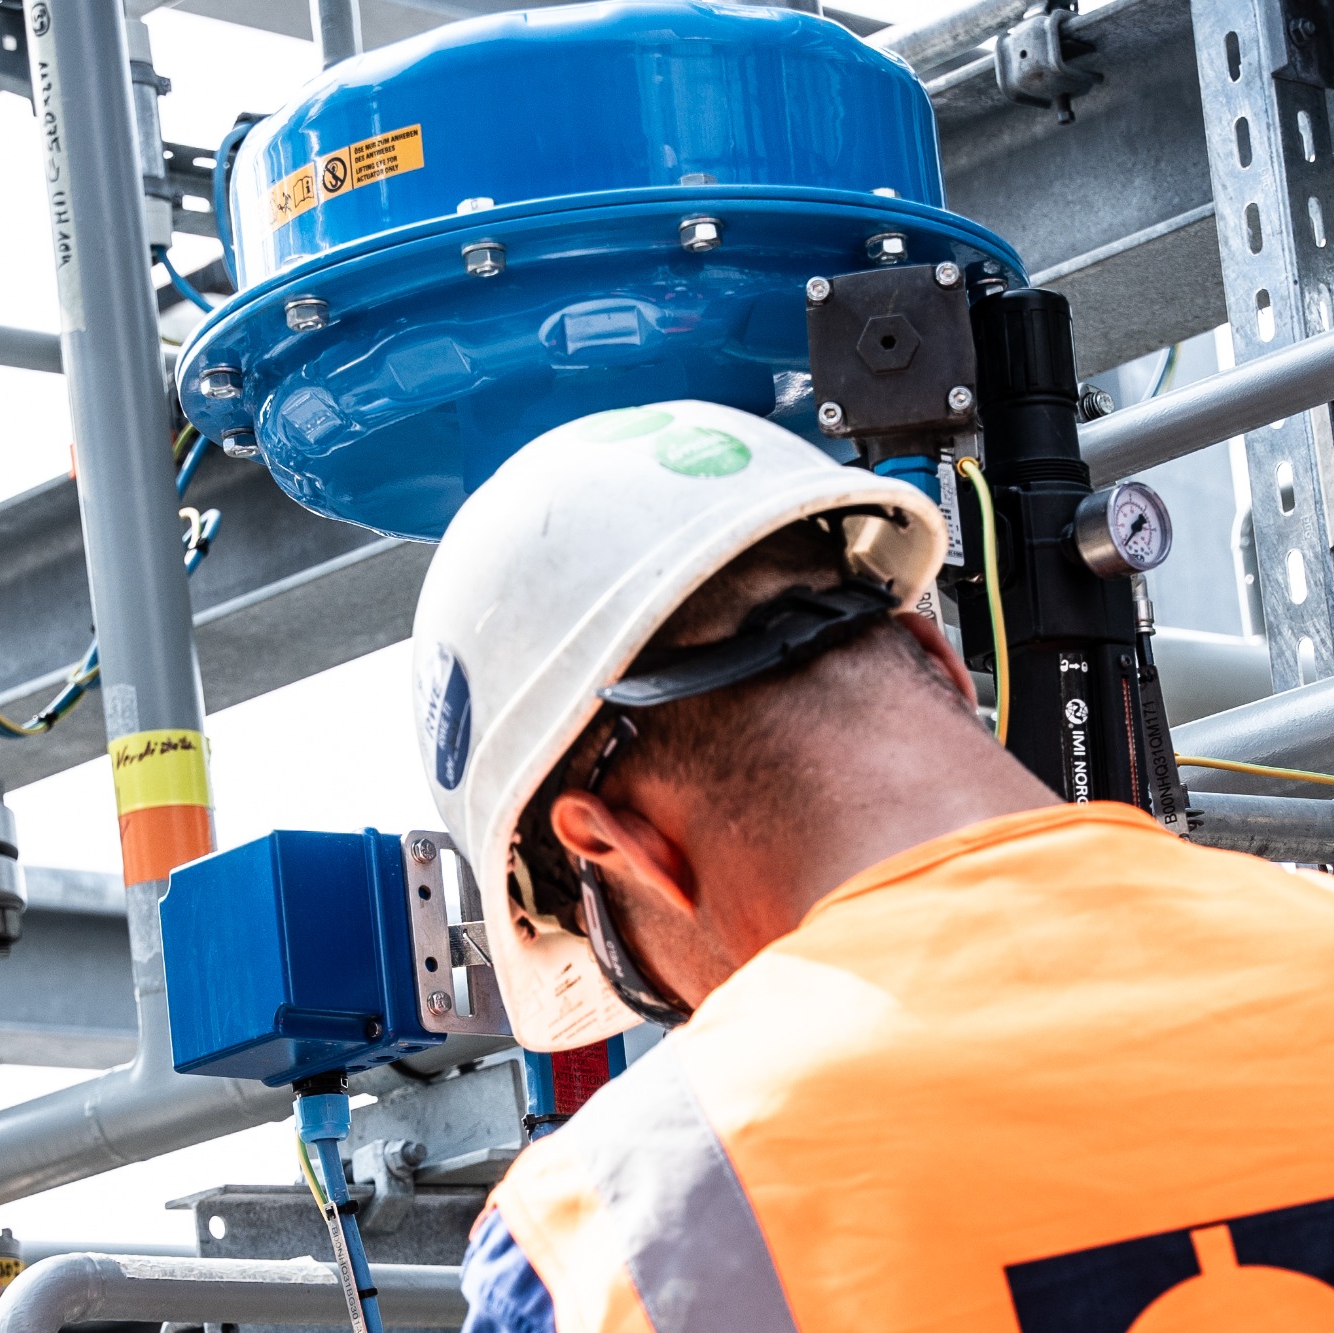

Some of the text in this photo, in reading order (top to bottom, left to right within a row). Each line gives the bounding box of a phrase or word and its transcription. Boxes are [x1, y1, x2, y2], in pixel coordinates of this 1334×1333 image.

[390, 129, 419, 142] ANHEBEN
[365, 145, 396, 160] ANTRIEBES
[355, 163, 375, 175] LIFTING
[386, 155, 398, 166] FOR
[384, 164, 399, 175] ONLY
[1072, 730, 1086, 756] IMI
